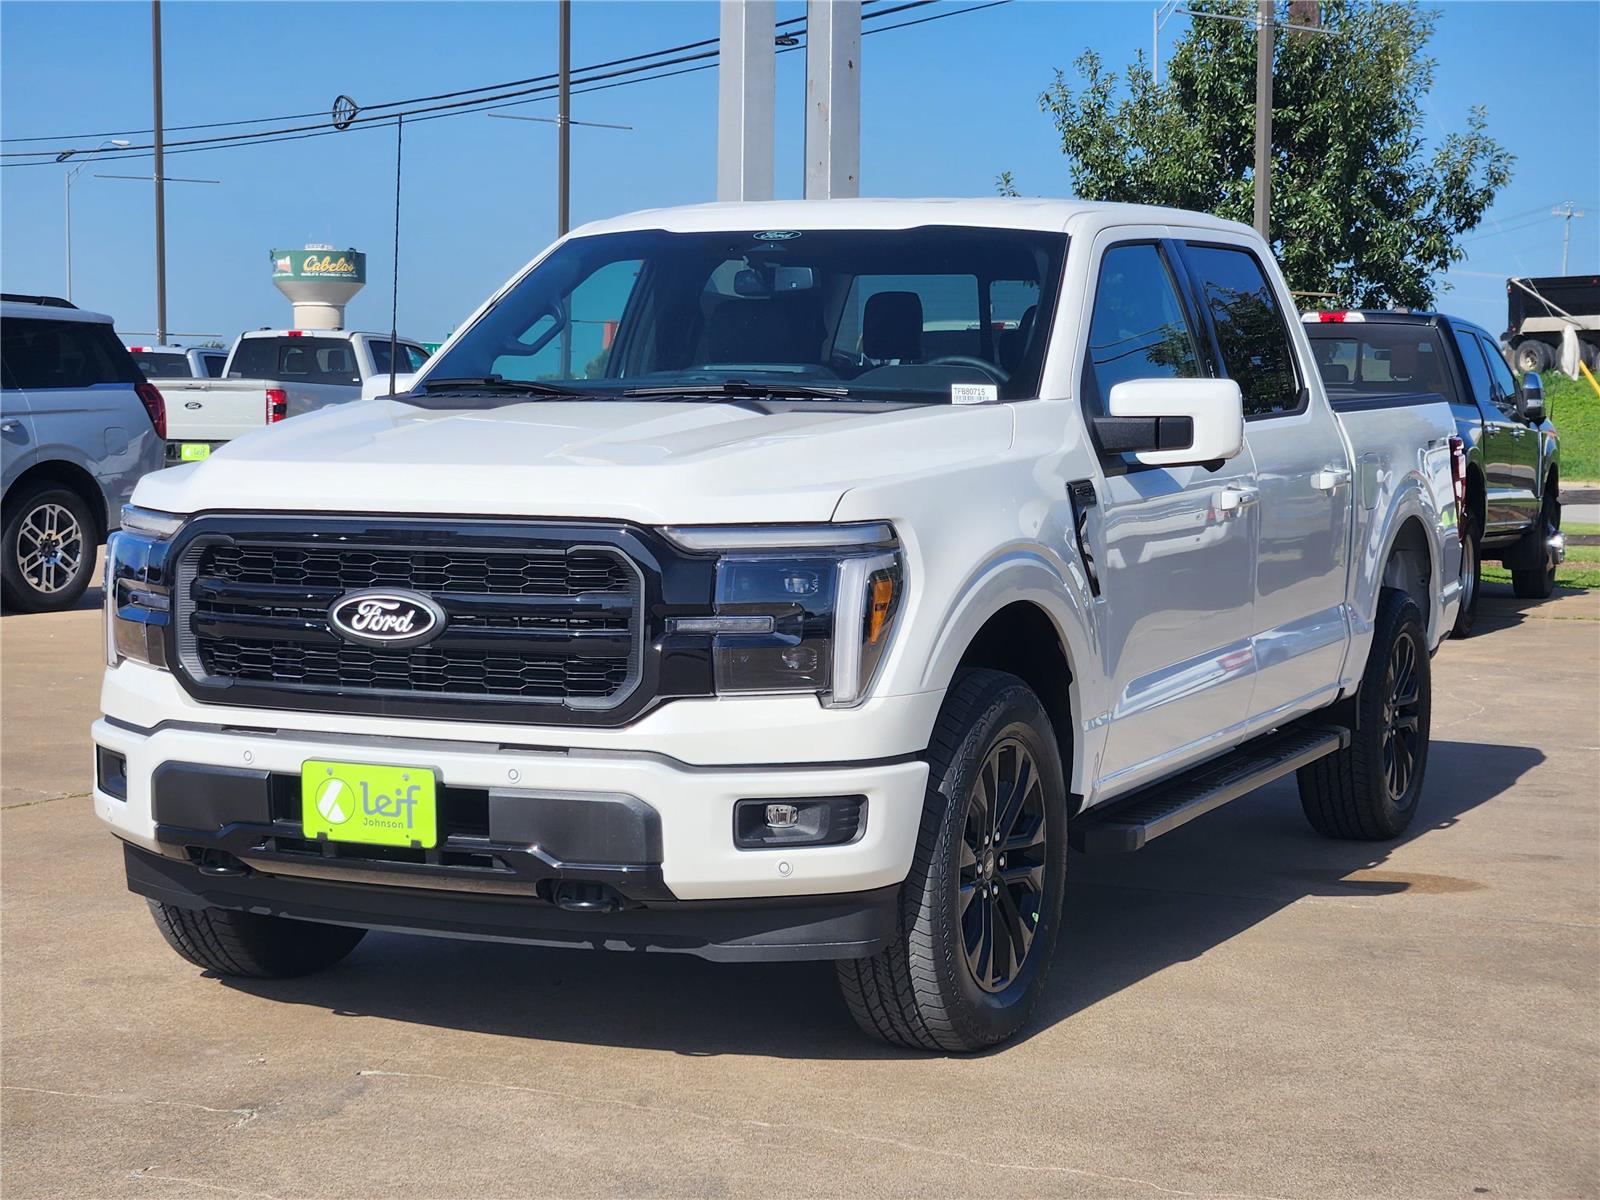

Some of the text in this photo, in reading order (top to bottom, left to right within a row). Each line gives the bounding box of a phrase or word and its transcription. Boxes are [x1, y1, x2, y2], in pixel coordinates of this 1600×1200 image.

[953, 387, 986, 396] TFB80715
[351, 600, 415, 632] Ford
[360, 781, 421, 829] leif
[363, 818, 404, 829] Johnson
